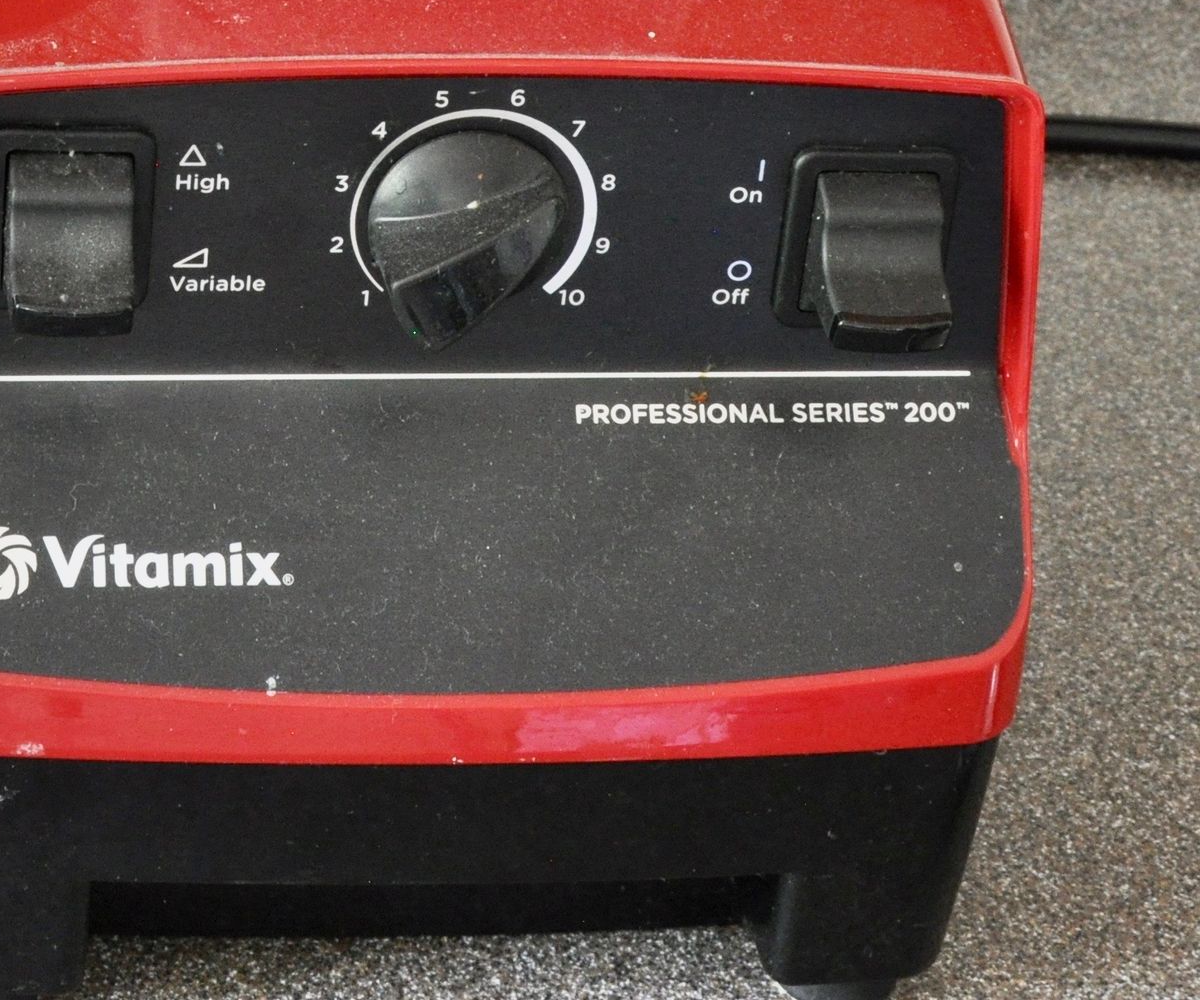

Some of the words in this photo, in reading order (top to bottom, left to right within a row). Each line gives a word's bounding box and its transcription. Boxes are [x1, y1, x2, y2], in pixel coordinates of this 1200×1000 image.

[434, 90, 450, 108] 5
[510, 89, 526, 107] 6
[371, 121, 388, 140] 4
[571, 120, 587, 138] 7
[175, 173, 230, 194] High
[334, 174, 349, 193] 3
[601, 173, 617, 192] 8
[729, 186, 763, 204] On
[329, 236, 344, 254] 2
[595, 237, 611, 255] 9
[169, 275, 266, 292] Variable
[361, 289, 370, 307] 1
[558, 289, 586, 307] 10
[711, 288, 750, 306] Off
[575, 403, 784, 425] PROFESSIONAL
